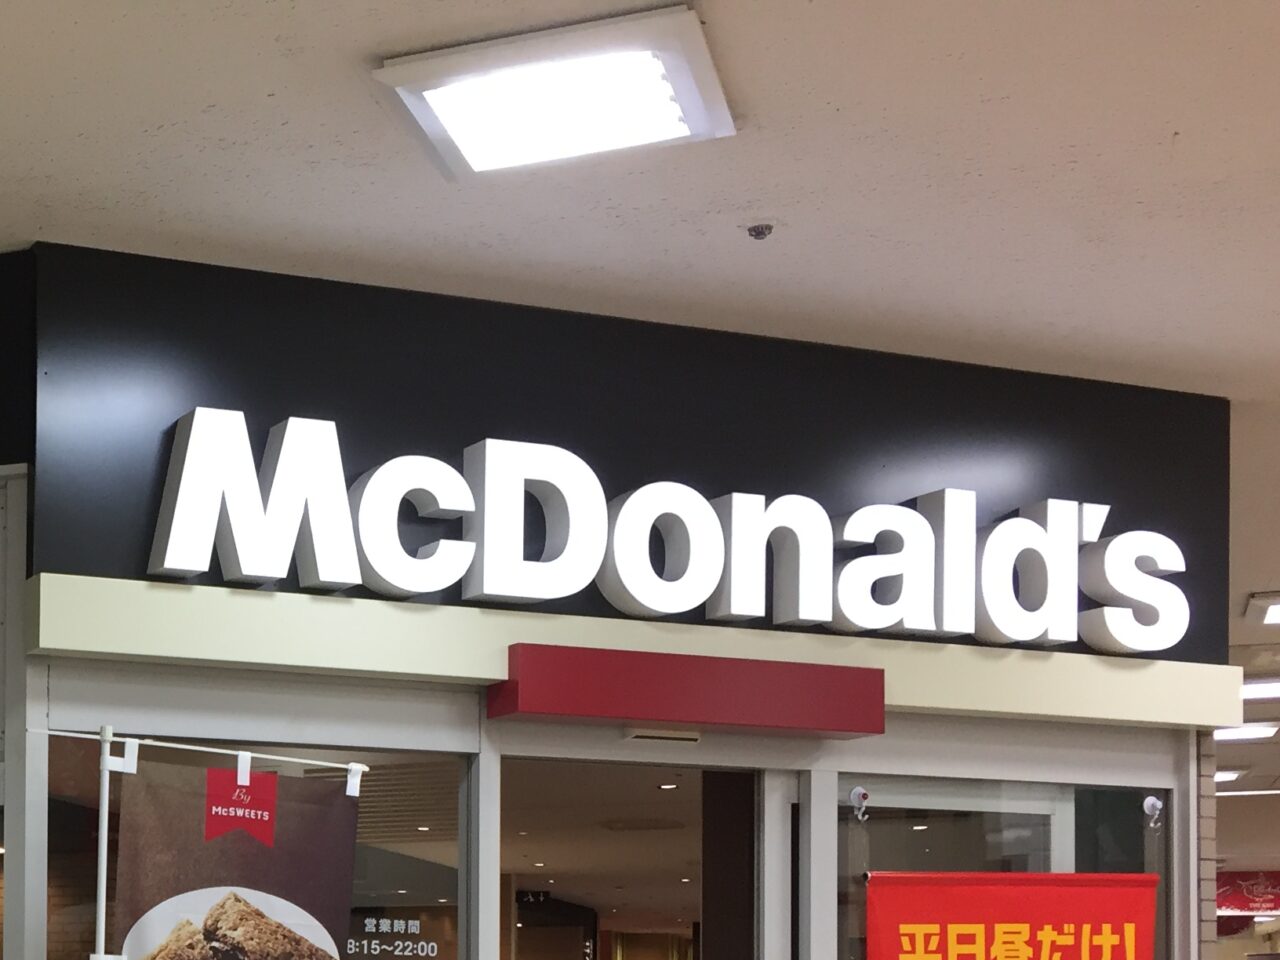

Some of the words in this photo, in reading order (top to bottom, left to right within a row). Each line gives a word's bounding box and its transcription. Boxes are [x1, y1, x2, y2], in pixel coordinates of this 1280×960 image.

[153, 405, 1192, 653] McDonald's
[232, 788, 252, 804] By
[211, 805, 270, 821] McSWEETS
[364, 917, 420, 934] 営業時間
